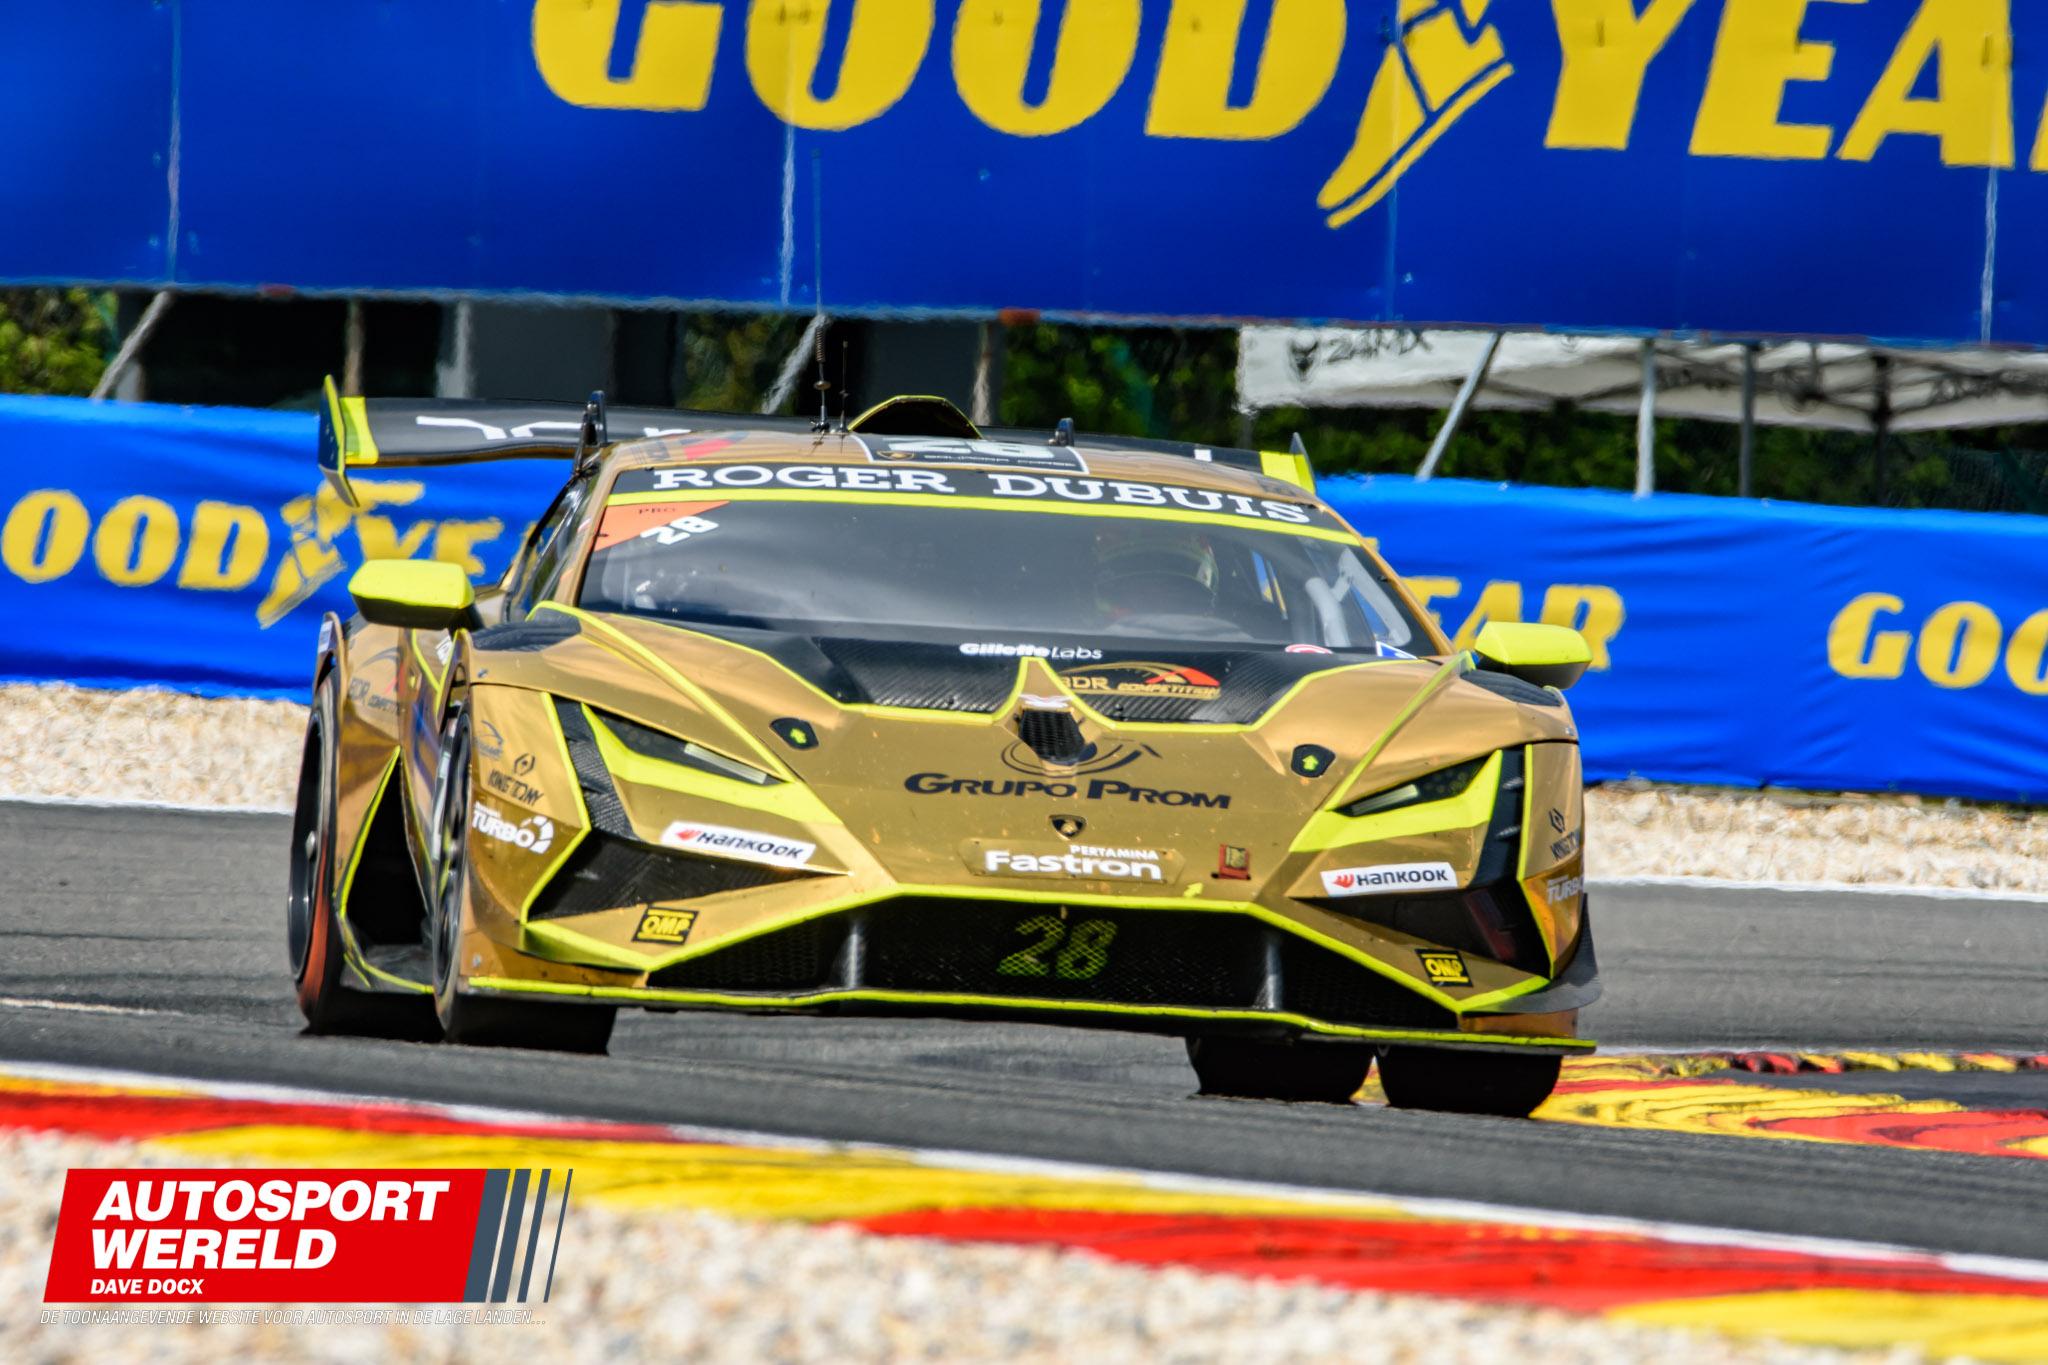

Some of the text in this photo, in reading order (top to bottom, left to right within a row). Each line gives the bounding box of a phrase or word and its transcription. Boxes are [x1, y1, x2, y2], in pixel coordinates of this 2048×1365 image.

[653, 465, 1310, 523] ROGER DUBUIS
[640, 515, 719, 545] 28
[904, 772, 1231, 809] GRUPO PROM
[472, 809, 535, 848] TURBO
[985, 850, 1162, 880] Fastron
[1070, 845, 1159, 861] PERTAMINA
[642, 916, 691, 935] OMP
[997, 915, 1118, 979] 28
[1425, 958, 1463, 977] OMP
